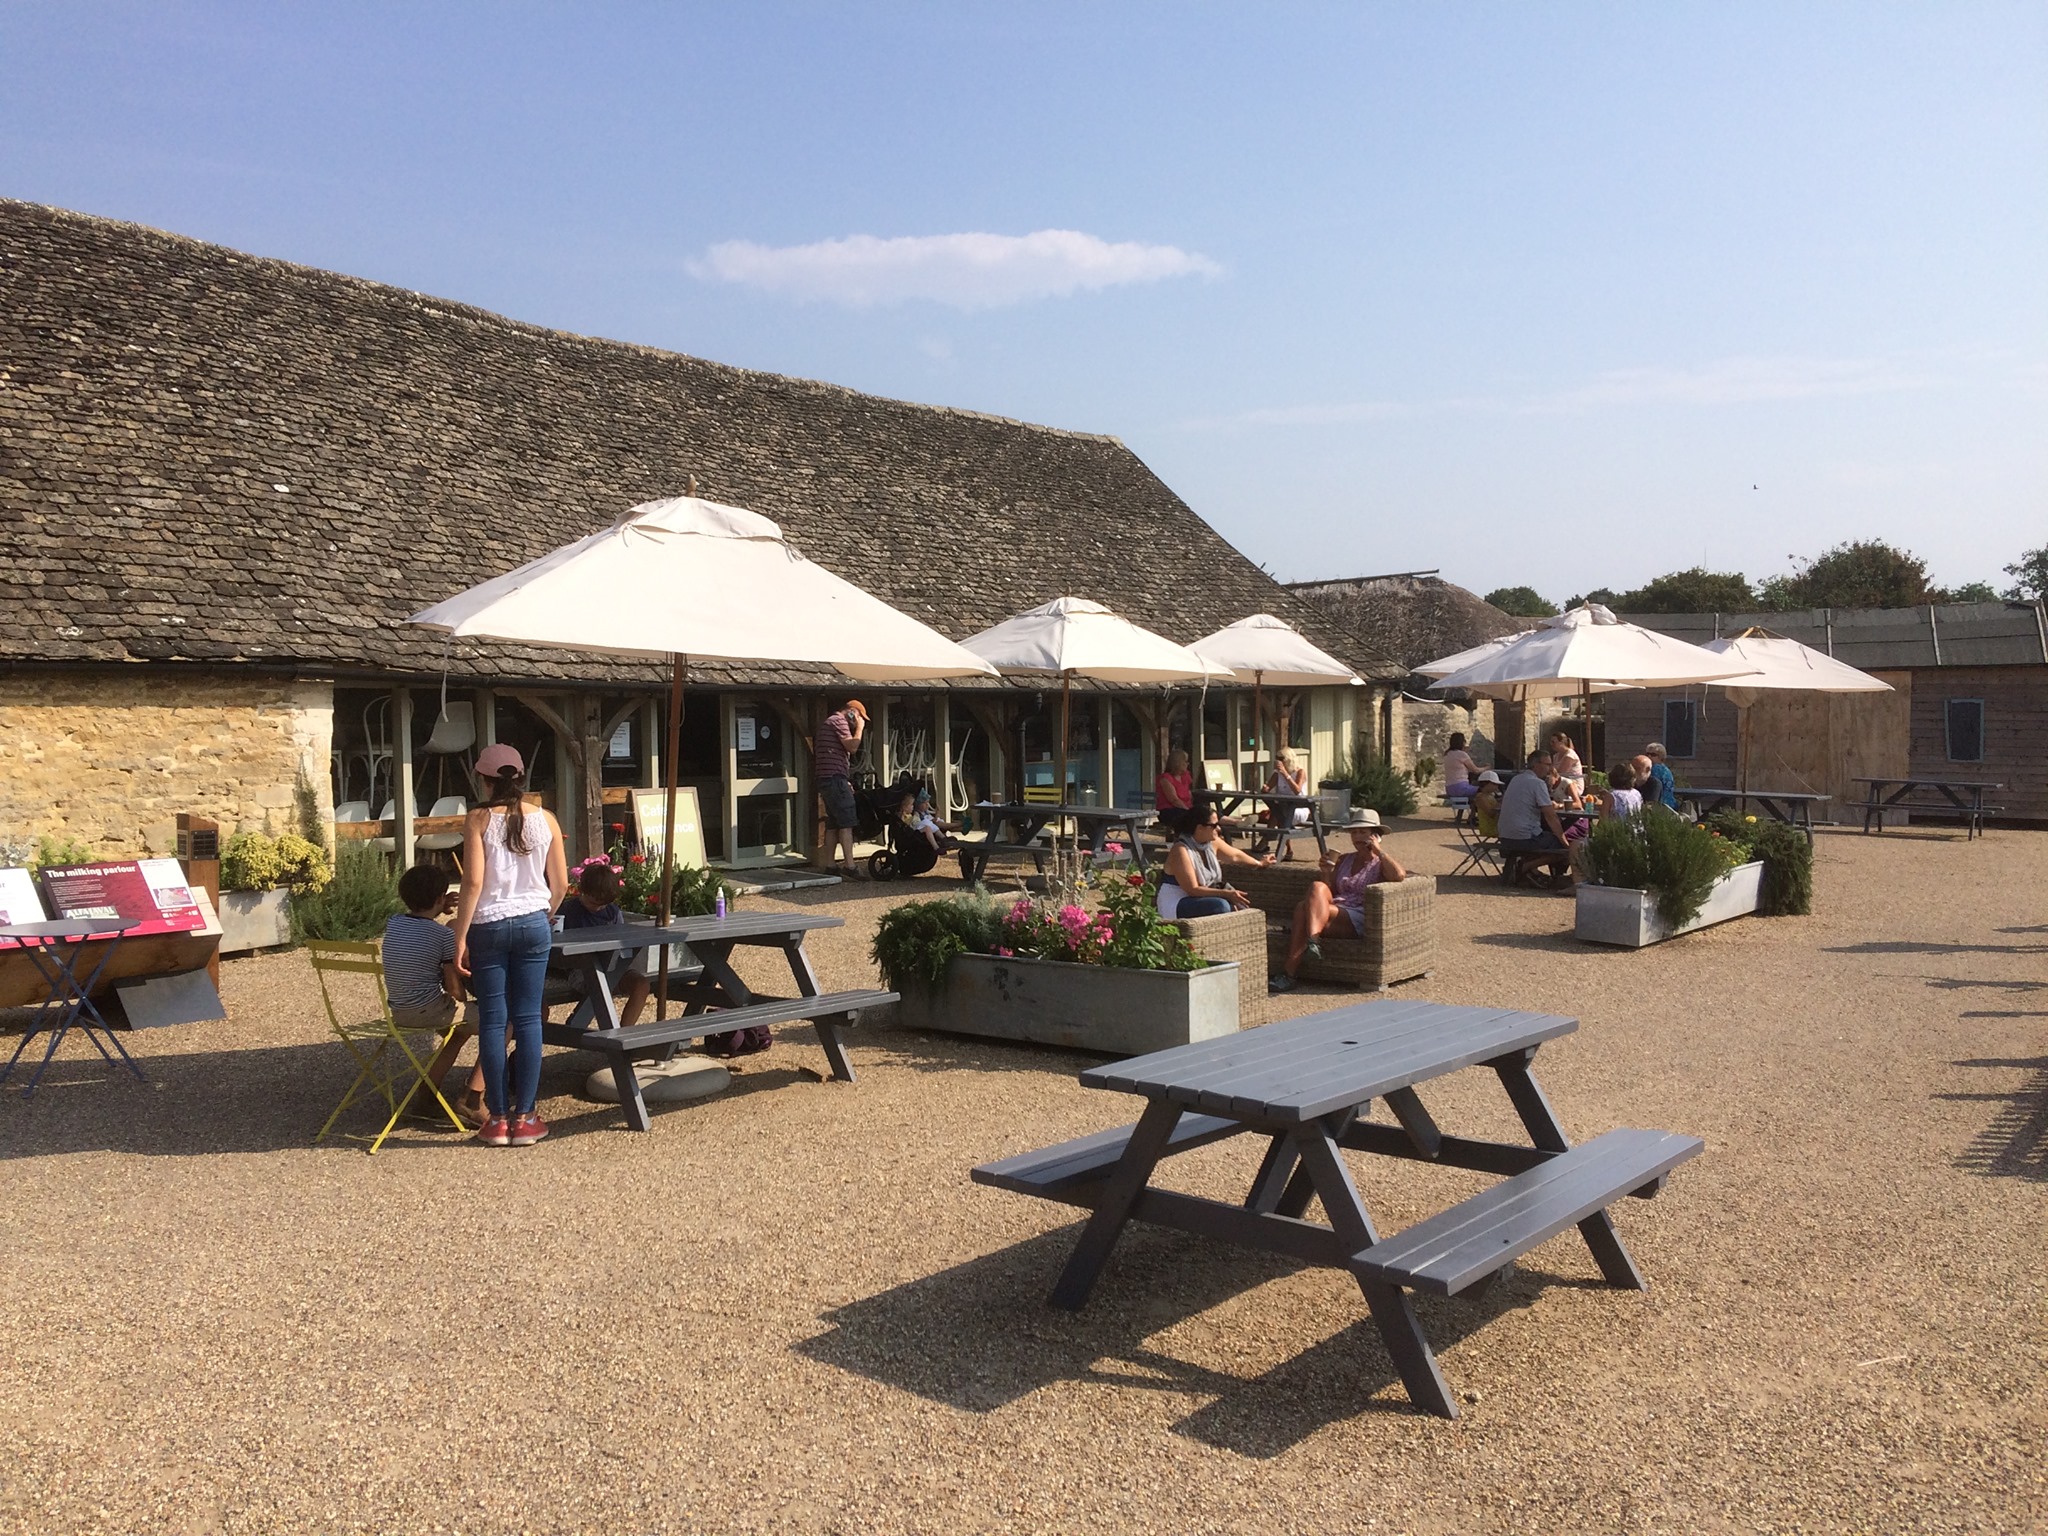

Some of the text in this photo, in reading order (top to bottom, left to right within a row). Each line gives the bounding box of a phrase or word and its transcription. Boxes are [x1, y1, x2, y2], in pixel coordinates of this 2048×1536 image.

[645, 822, 695, 835] entnce
[46, 865, 136, 878] The milking parlour
